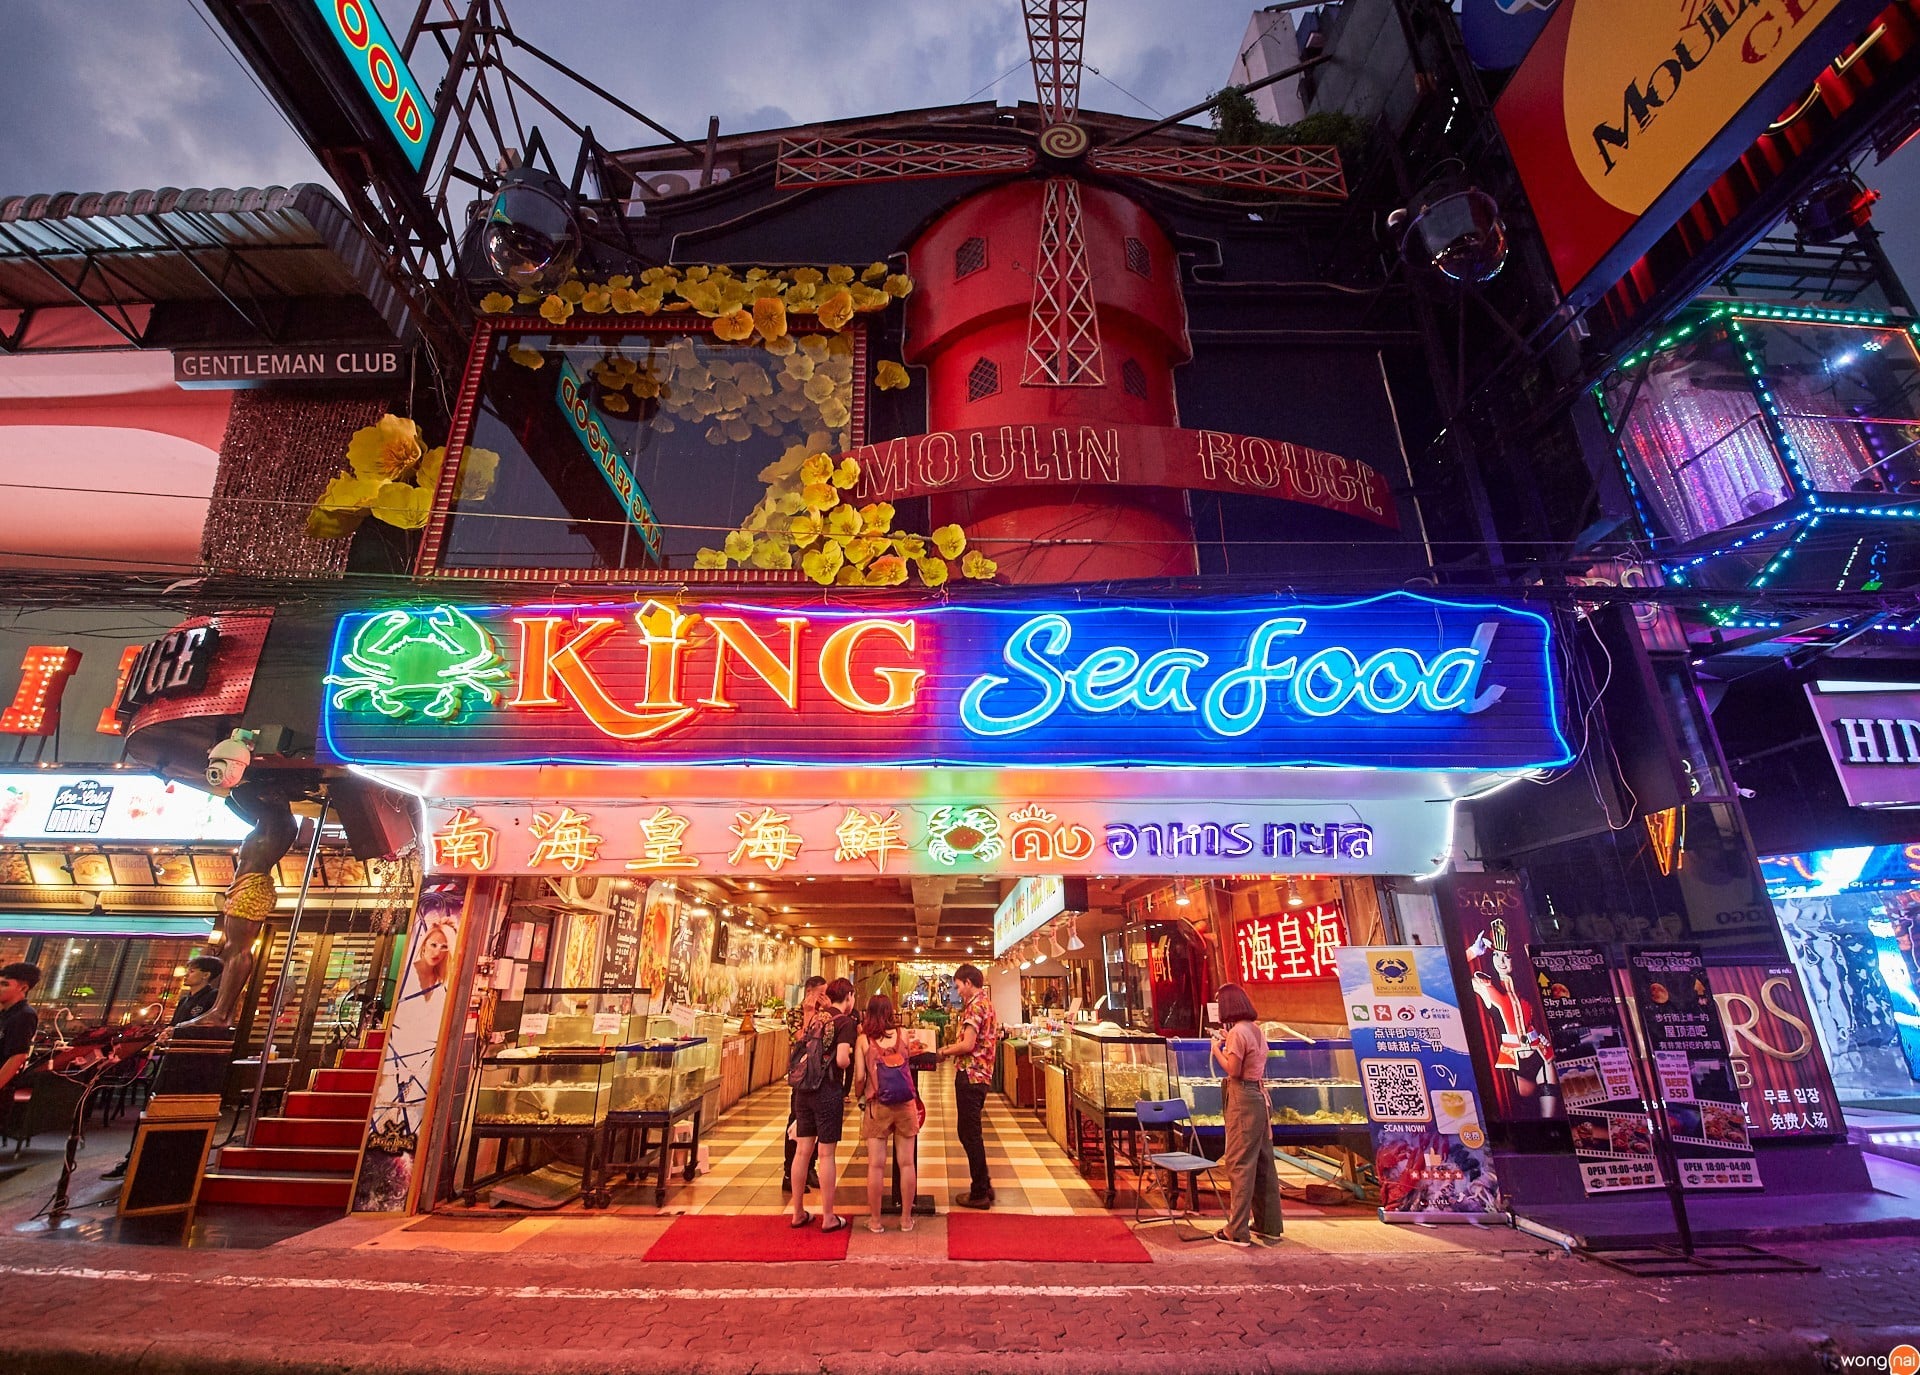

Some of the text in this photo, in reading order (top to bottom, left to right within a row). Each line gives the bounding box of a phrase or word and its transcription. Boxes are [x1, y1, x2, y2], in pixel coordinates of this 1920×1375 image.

[182, 353, 397, 375] GENTLEMAN CLUB
[857, 426, 1382, 516] MOULIN ROUGE
[47, 809, 105, 832] DRINKS
[1457, 888, 1520, 908] STARS
[1238, 906, 1341, 981] 海皇海
[1532, 956, 1566, 968] The
[1568, 954, 1604, 965] Roof
[1633, 956, 1702, 967] The Roof
[1544, 998, 1560, 1006] Sky
[1546, 1009, 1581, 1018] 空中酒吧
[1664, 1025, 1708, 1037] 屋顶酒吧
[1377, 1041, 1443, 1053] 美味甜点一份
[1665, 1078, 1690, 1087] BEER
[1669, 1089, 1689, 1098] 55B
[1764, 1088, 1819, 1104] 무료 입장
[1384, 1124, 1426, 1132] SCAN NOW!
[1770, 1113, 1828, 1130] 免费入场
[1587, 1162, 1653, 1176] OPEN 18:00~04:00
[1684, 1162, 1751, 1172] OPEN 18:00~04:00
